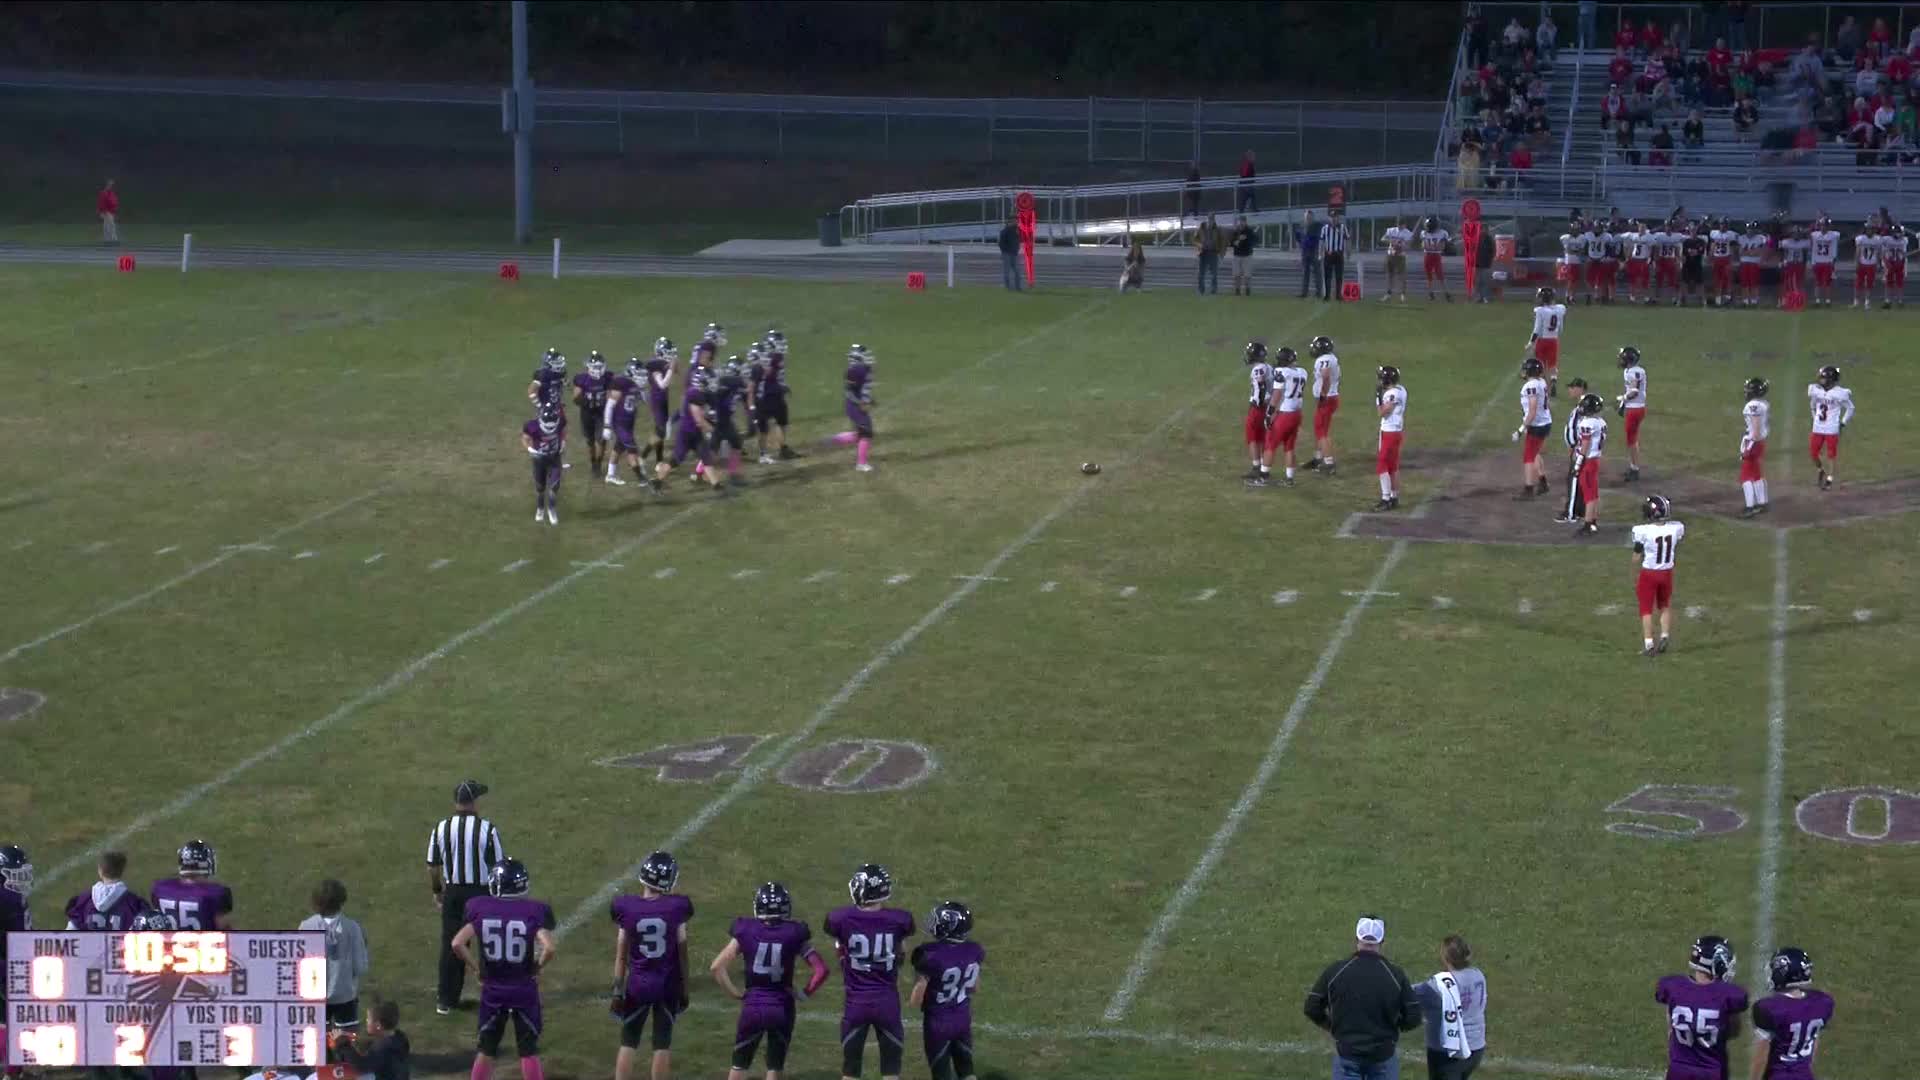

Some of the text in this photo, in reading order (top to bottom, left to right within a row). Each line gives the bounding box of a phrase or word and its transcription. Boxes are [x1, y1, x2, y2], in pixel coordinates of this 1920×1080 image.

[1819, 404, 1828, 421] 3
[1655, 534, 1673, 564] 11
[592, 733, 942, 794] 40
[1604, 784, 1920, 846] 50
[482, 918, 527, 963] 56
[636, 918, 667, 959] 3
[850, 933, 895, 971] 24
[752, 942, 784, 982] 4
[936, 962, 980, 1004] 32
[1671, 1005, 1720, 1048] 65
